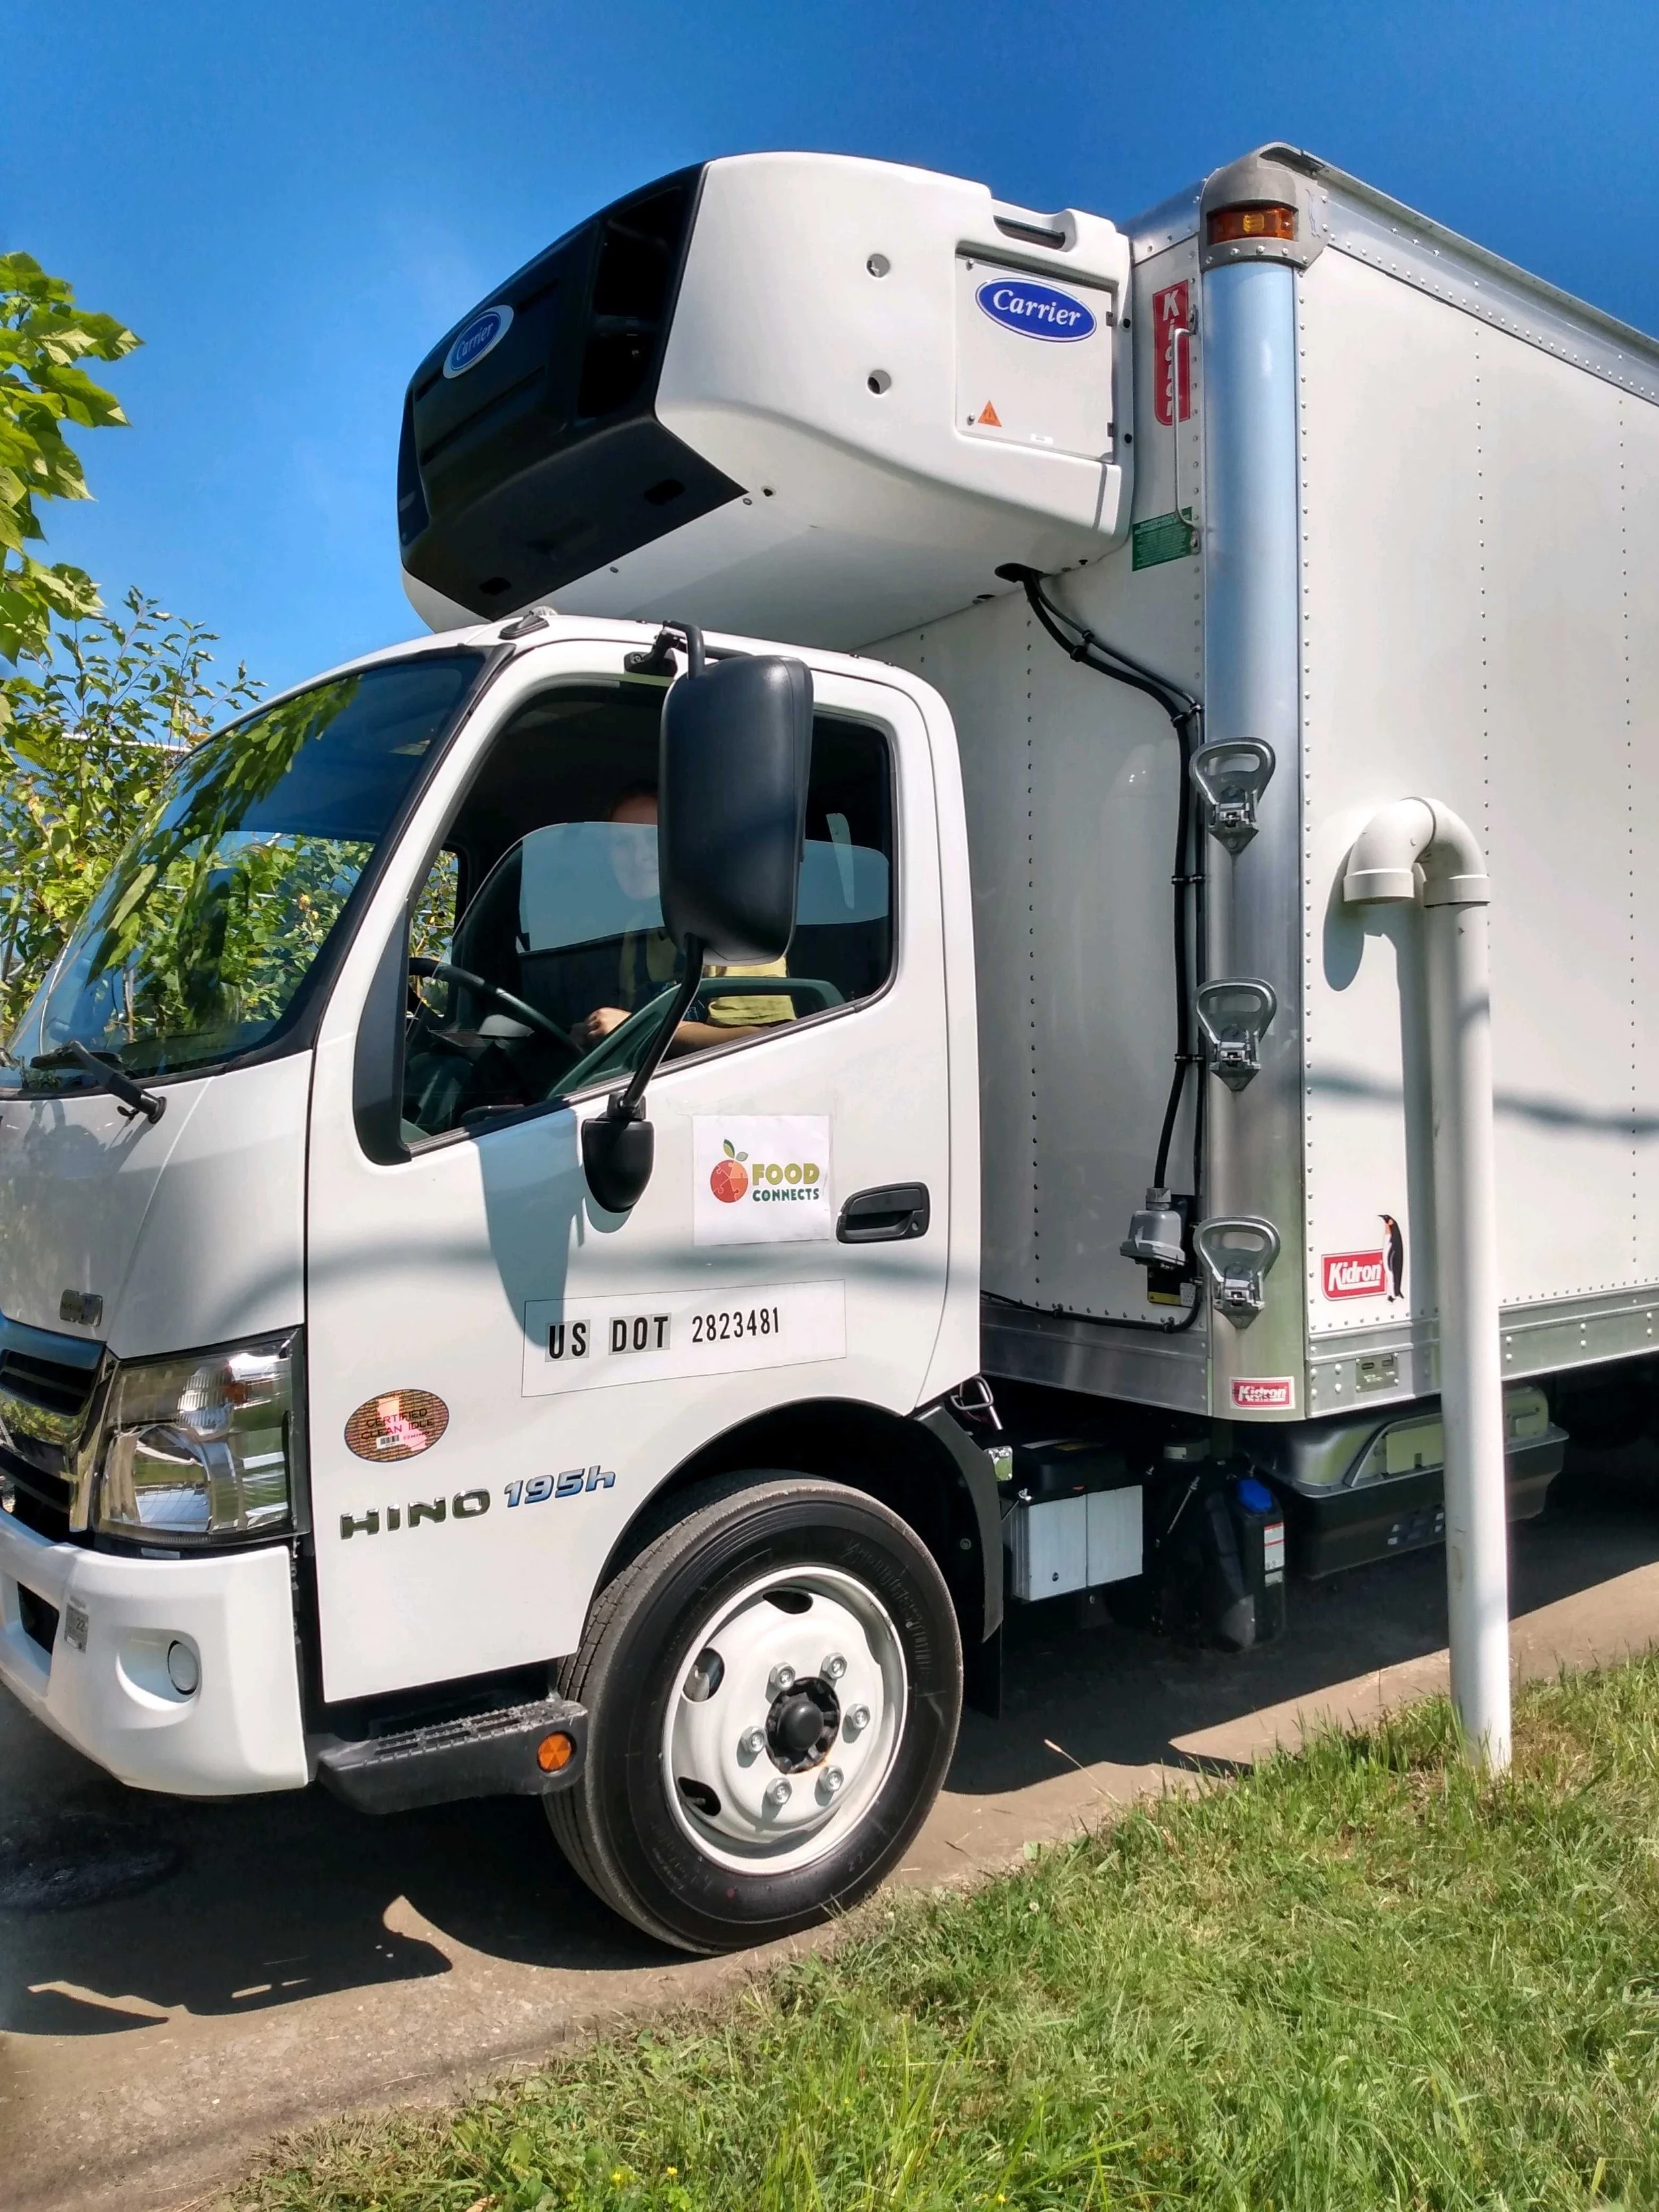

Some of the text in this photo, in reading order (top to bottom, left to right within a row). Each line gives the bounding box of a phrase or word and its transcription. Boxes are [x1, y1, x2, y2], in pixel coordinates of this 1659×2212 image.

[993, 289, 1081, 327] Carrier
[457, 322, 494, 361] Carrier
[752, 1163, 820, 1186] FOOD
[752, 1187, 820, 1203] CONNECTS
[1328, 1260, 1382, 1291] Kidron
[549, 1306, 780, 1360] US DOT 2823481
[1238, 1385, 1287, 1402] Kidron
[361, 1418, 435, 1439] CLEAN IDLE
[366, 1408, 428, 1428] CERTIFIED
[340, 1465, 616, 1540] HINO 195h
